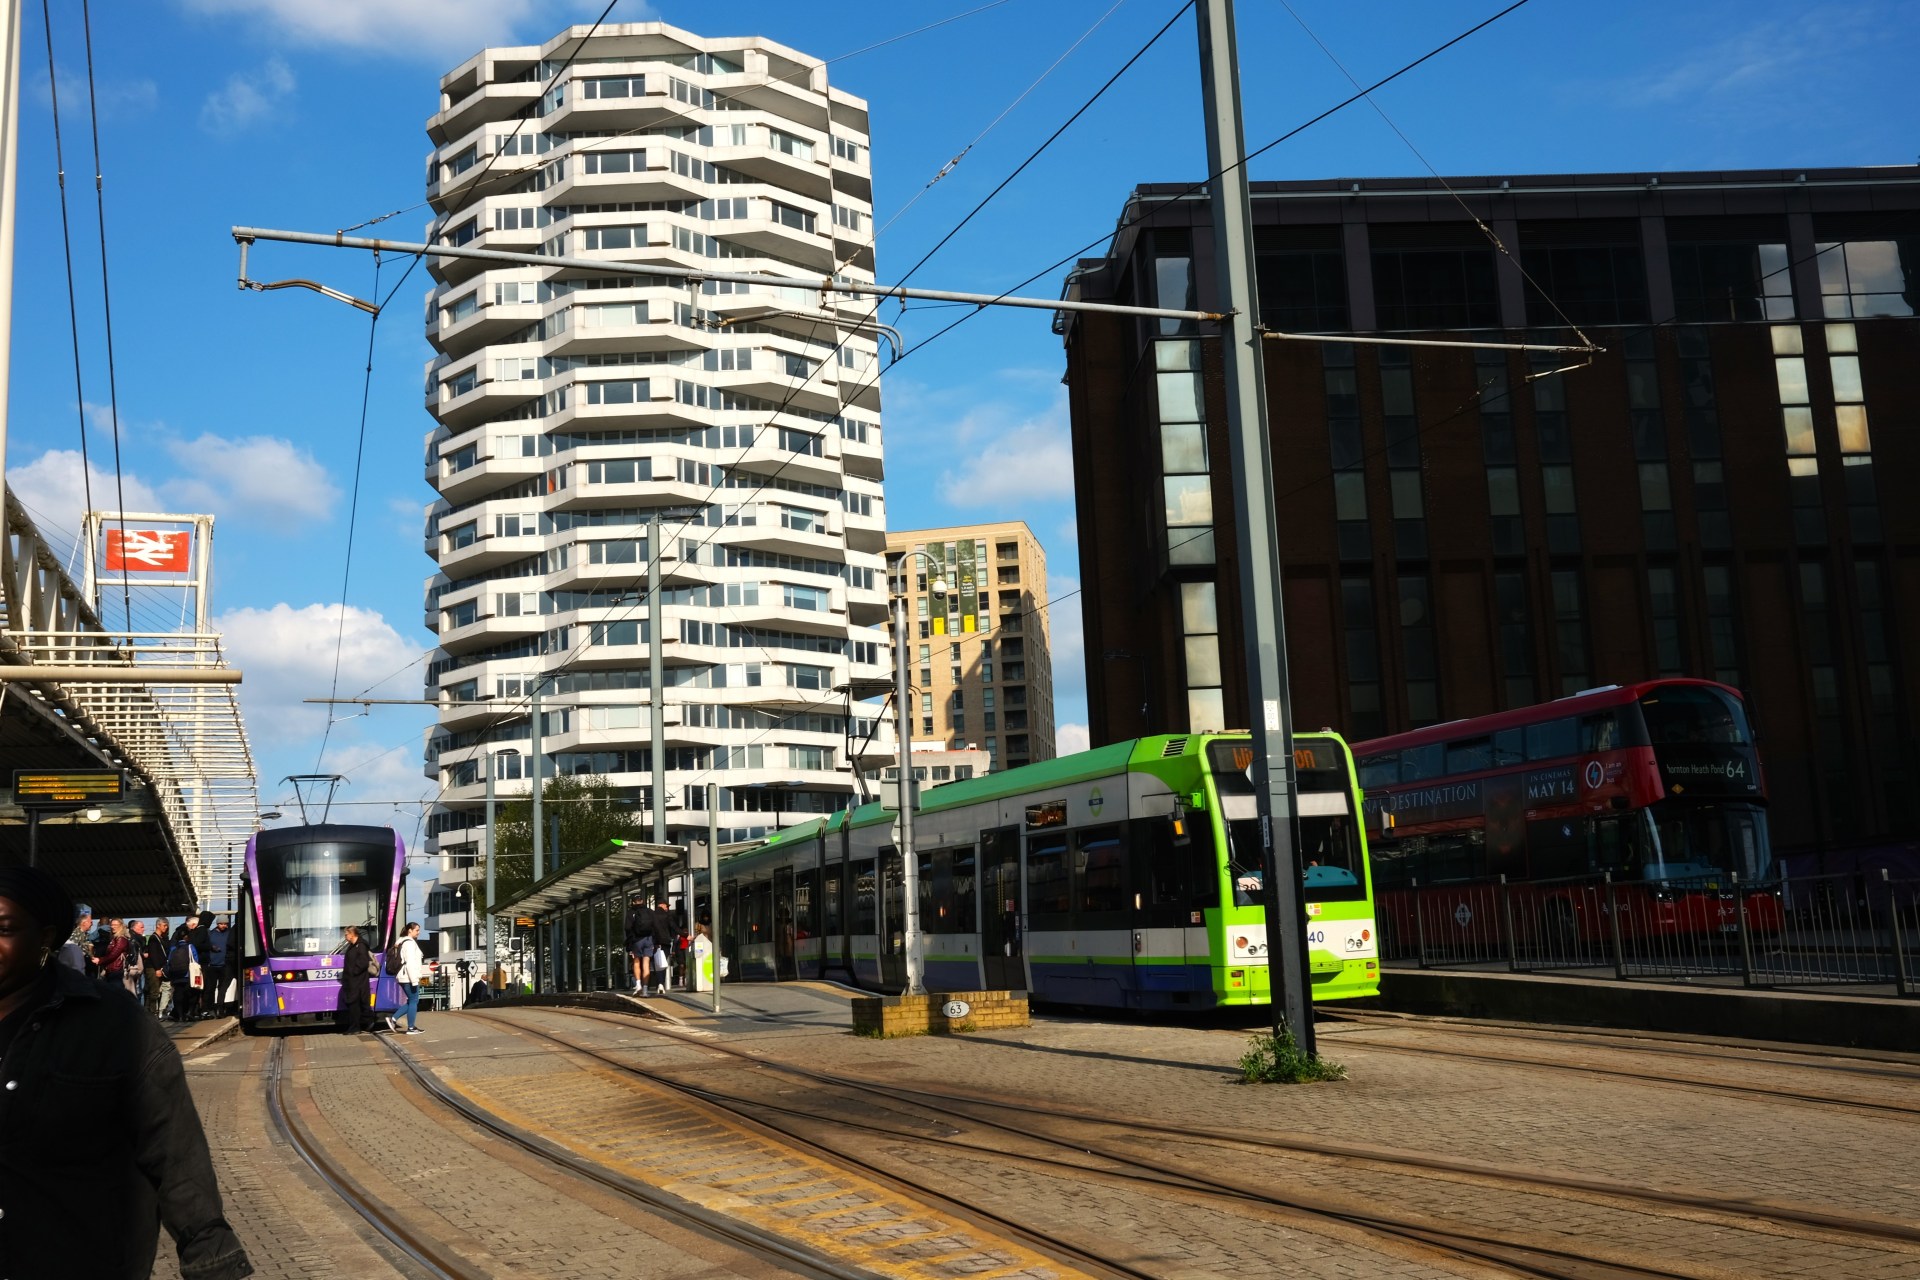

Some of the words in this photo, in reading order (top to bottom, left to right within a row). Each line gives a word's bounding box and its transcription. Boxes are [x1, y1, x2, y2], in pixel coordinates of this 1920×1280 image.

[1666, 763, 1690, 774] hornton
[1691, 763, 1710, 774] Heath
[1711, 763, 1725, 774] Pond
[1726, 760, 1745, 778] 64
[1540, 769, 1571, 781] CINEMAS
[1528, 781, 1556, 800] MAY
[1562, 778, 1575, 795] 14
[1390, 783, 1476, 810] DESTINATION
[315, 969, 340, 979] 2554
[950, 1004, 962, 1014] 63
